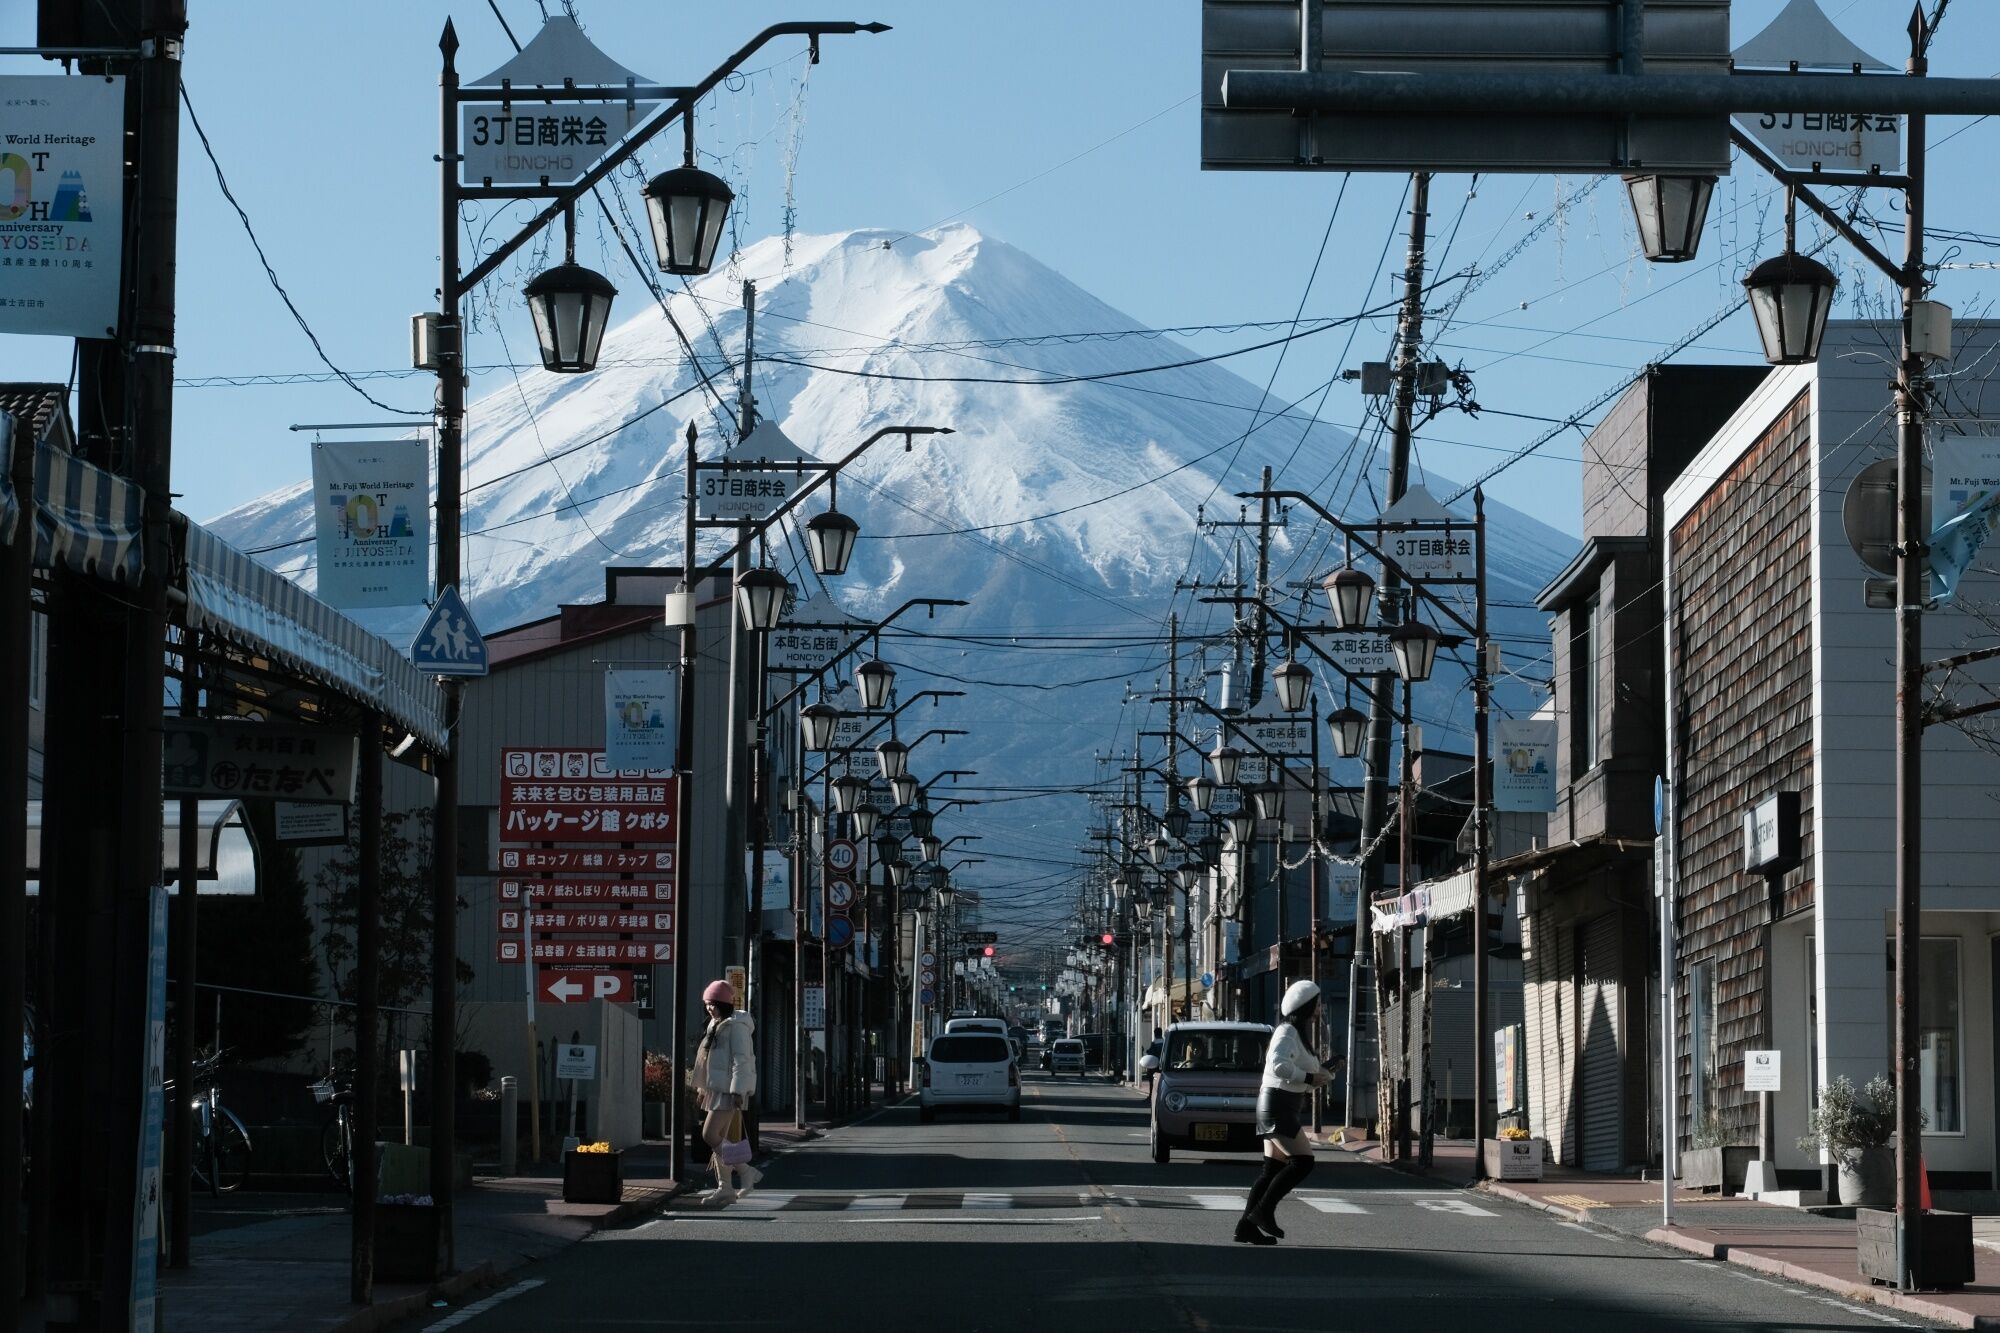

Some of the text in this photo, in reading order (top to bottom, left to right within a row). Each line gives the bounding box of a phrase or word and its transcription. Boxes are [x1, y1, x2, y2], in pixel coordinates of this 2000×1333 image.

[473, 116, 607, 146] 3丁目商栄会
[5, 133, 96, 147] World Heritage
[343, 483, 358, 491] Fuji
[360, 482, 381, 490] World
[383, 480, 415, 489] Heritage
[705, 478, 786, 497] 3丁目商栄会
[1964, 478, 1980, 488] Fuji
[353, 539, 398, 547] Anniversary
[1396, 539, 1471, 556] 3丁目商栄会
[775, 635, 838, 650] 本町名店街
[1256, 727, 1307, 739] 本町名店街
[242, 763, 335, 796] たなべ
[512, 785, 665, 802] 未来を包む包装用品店
[507, 809, 669, 831] パッケージ館 クボタ
[526, 854, 568, 865] 紙コップ
[583, 854, 602, 865] 紙袋
[618, 855, 648, 865] ラップ
[833, 849, 851, 863] 40
[528, 885, 545, 896] 文具
[555, 885, 601, 896] 紙おしぼり
[619, 915, 648, 927] 手提袋
[531, 945, 564, 957] 品容器
[576, 945, 616, 957] 生活雑貨
[594, 975, 621, 998] P
